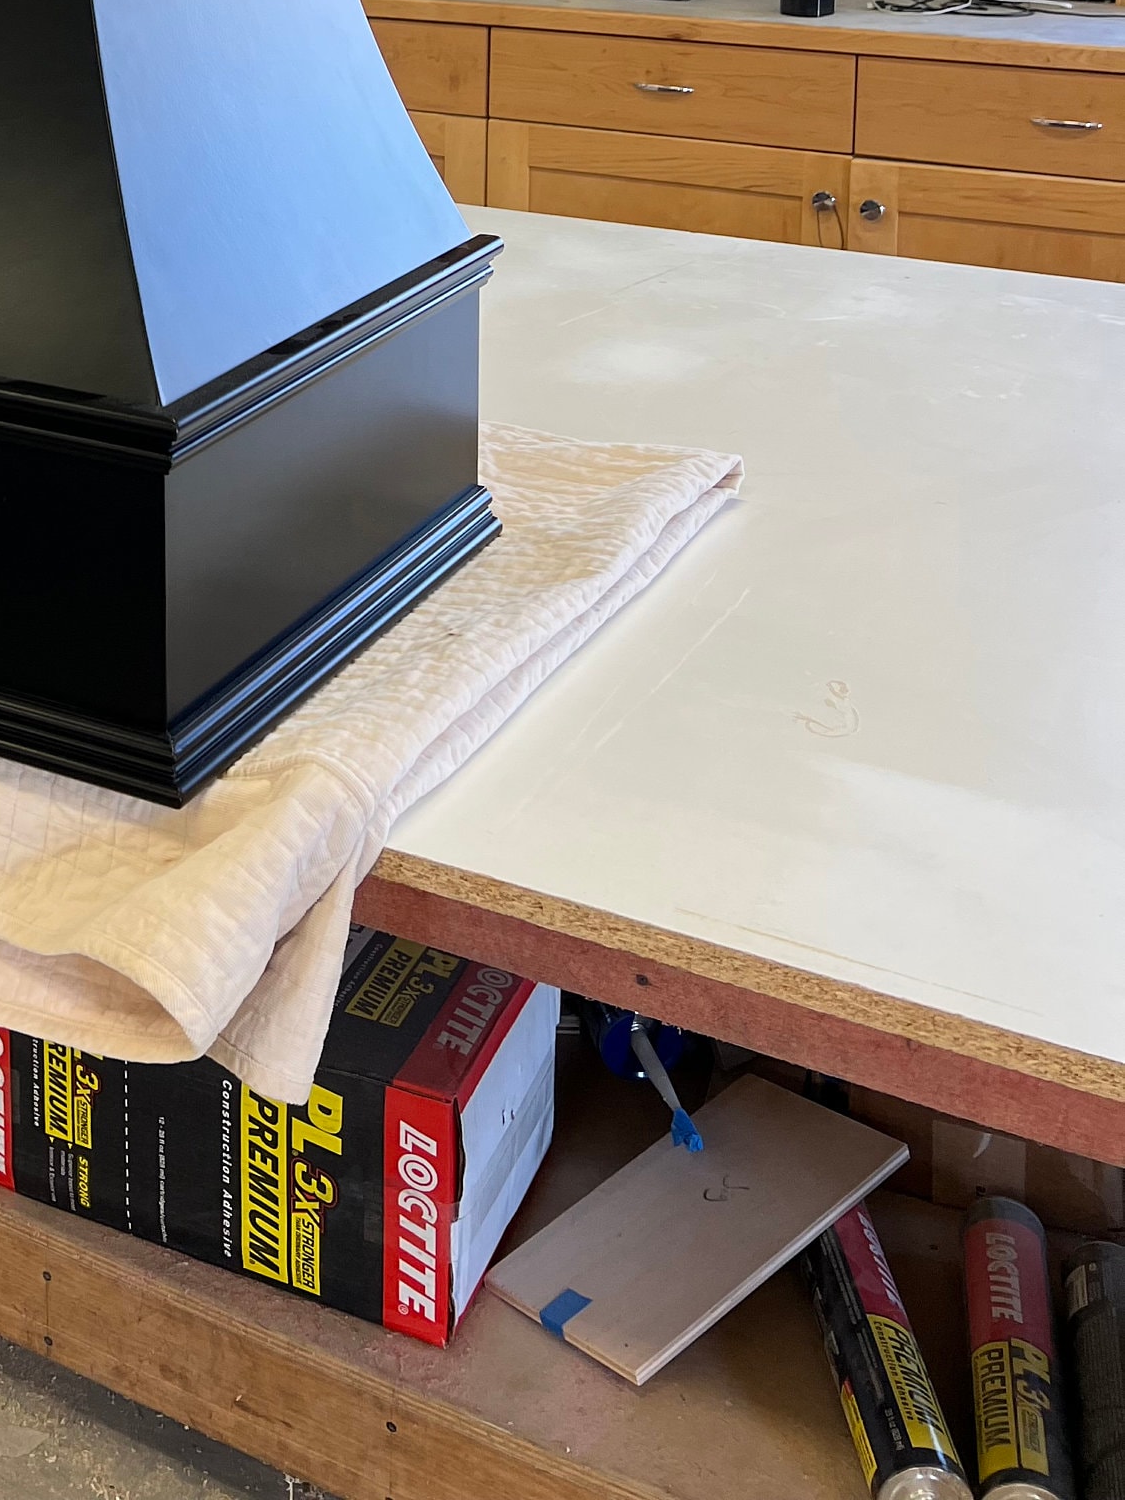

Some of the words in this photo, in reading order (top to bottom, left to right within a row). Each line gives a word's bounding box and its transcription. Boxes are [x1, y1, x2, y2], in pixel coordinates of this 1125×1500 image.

[351, 949, 413, 1016] PREMIUM
[424, 948, 460, 979] PL
[437, 968, 513, 1055] OCTITE
[33, 1082, 41, 1127] Adhesive
[47, 1042, 69, 1137] REMIUM
[79, 1101, 89, 1145] STRONGER
[222, 1079, 233, 1184] Construction
[291, 1084, 344, 1156] PL
[78, 1156, 91, 1208] STRONG
[222, 1188, 233, 1258] Adhesive
[248, 1089, 280, 1275] PREMIUM
[398, 1120, 438, 1322] LOCTITE
[301, 1217, 315, 1290] STRONGER
[985, 1232, 1023, 1324] LOCTITE
[874, 1321, 899, 1378] Construction
[895, 1379, 914, 1421] Adhesive
[884, 1323, 945, 1434] PREMIUM
[979, 1348, 1012, 1448] PREMIUM
